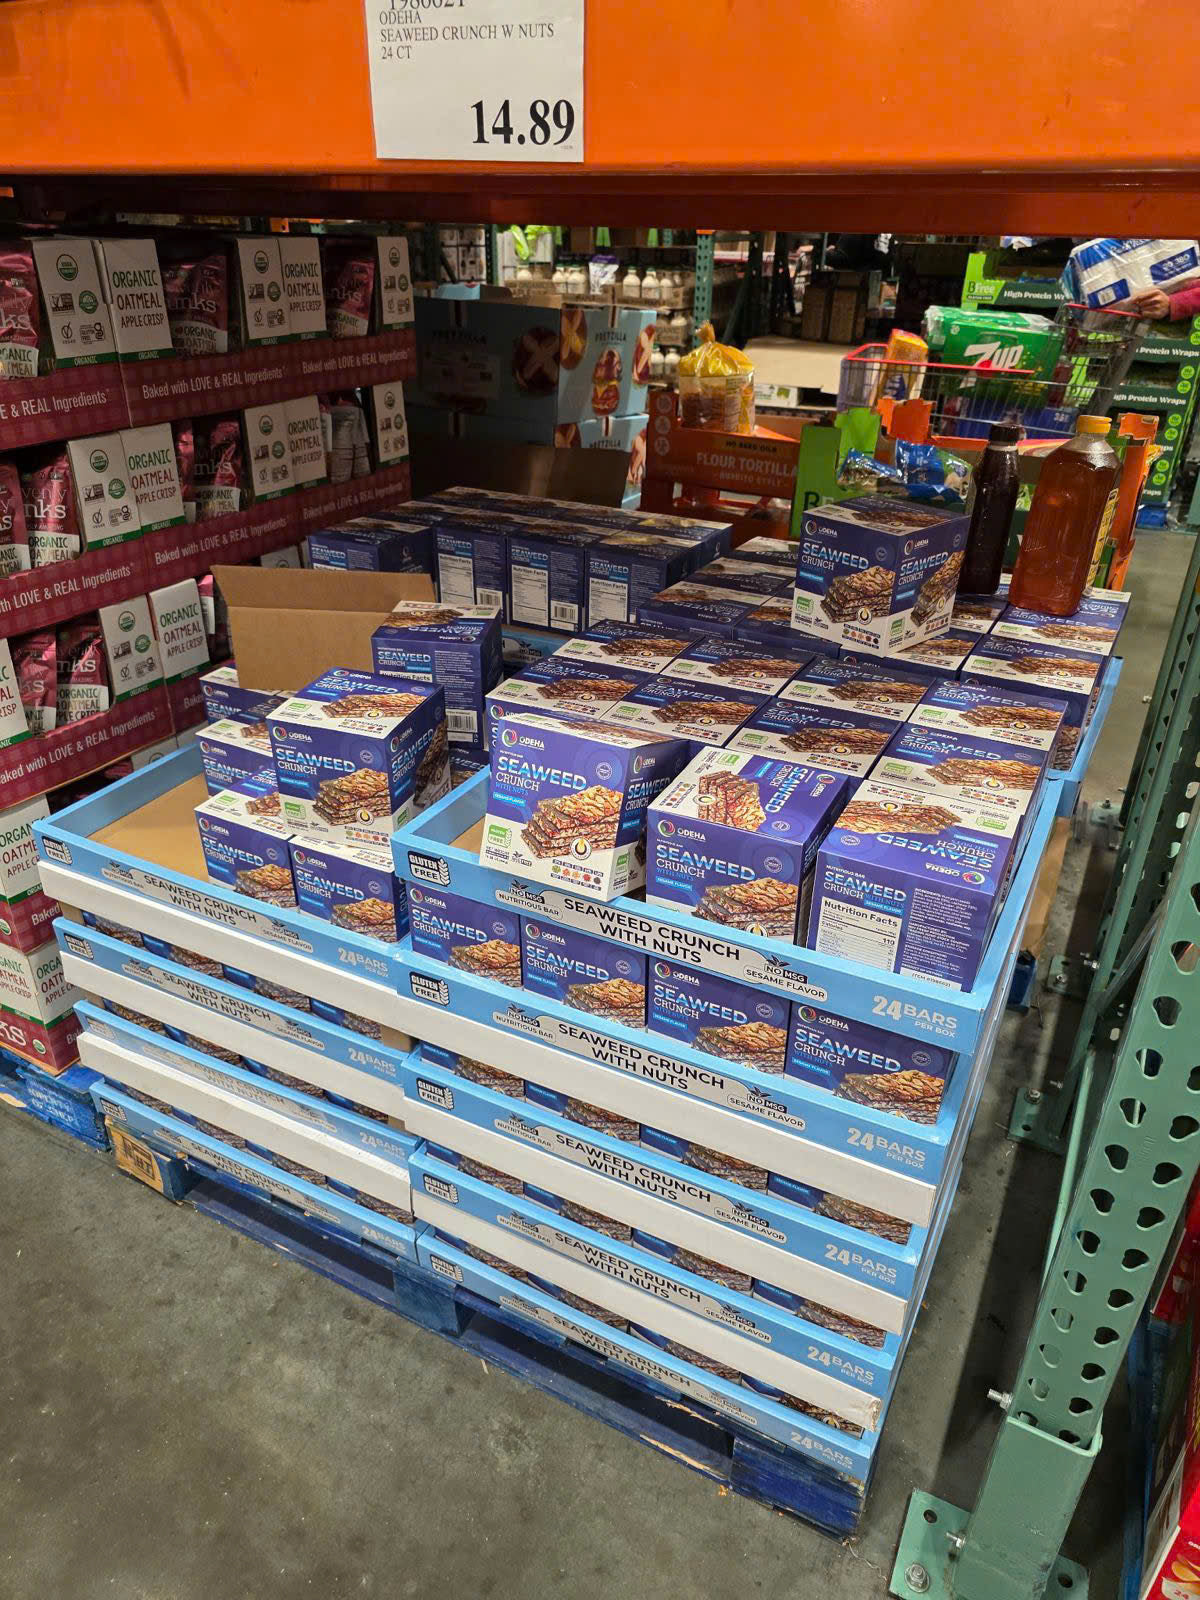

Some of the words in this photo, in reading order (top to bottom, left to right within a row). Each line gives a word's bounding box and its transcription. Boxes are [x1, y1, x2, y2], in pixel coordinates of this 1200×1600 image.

[380, 11, 422, 25] ODEHA
[380, 27, 438, 42] SEAWEED
[443, 25, 497, 40] CRUNCH
[502, 24, 514, 38] W
[519, 23, 554, 38] NUTS
[381, 46, 393, 60] 24
[396, 46, 412, 59] CT
[471, 99, 575, 145] 14.89
[113, 269, 158, 288] ORGANIC
[285, 263, 319, 278] ORGANIC
[117, 293, 162, 310] OATMEAL
[287, 283, 321, 298] OATMEAL
[1004, 290, 1022, 299] High
[1024, 291, 1052, 300] Protein
[302, 361, 323, 374] Baked
[338, 356, 355, 369] LOVE
[362, 353, 377, 365] REAL
[1140, 347, 1170, 355] Protein
[1172, 348, 1199, 358] Wraps
[142, 384, 169, 400] Baked
[171, 380, 189, 395] with
[190, 376, 211, 392] LOVE
[214, 376, 221, 388] &
[222, 373, 243, 387] REAL
[21, 398, 52, 416] REAL
[53, 391, 107, 413] Ingredients
[1128, 394, 1158, 403] Protein
[129, 448, 172, 470] ORGANIC
[696, 452, 736, 469] FLOUR
[132, 469, 174, 489] OATMEAL
[155, 548, 179, 565] Baked
[181, 542, 199, 557] with
[200, 535, 220, 551] LOVE
[230, 528, 249, 542] REAL
[512, 548, 549, 561] SEAWEED
[802, 542, 869, 570] SEAWEED
[590, 561, 629, 575] SEAWEED
[801, 555, 835, 571] CRUNCH
[900, 551, 949, 577] SEAWEED
[14, 590, 40, 609] LOVE
[54, 581, 81, 598] REAL
[82, 565, 131, 589] Ingredients
[898, 571, 923, 586] CRUNCH
[160, 603, 199, 628] ORGANIC
[163, 622, 202, 645] OATMEAL
[378, 650, 431, 664] SEAWEED
[321, 676, 399, 695] SEAWEED
[938, 685, 1027, 708] SEAWEED
[765, 705, 856, 729] SEAWEED
[26, 757, 47, 773] with
[49, 745, 73, 764] LOVE
[85, 730, 110, 747] REAL
[519, 735, 545, 749] ODEHA
[903, 734, 1002, 761] SEAWEED
[276, 748, 356, 773] SEAWEED
[278, 761, 317, 776] CRUNCH
[496, 773, 541, 792] CRUNCH
[497, 756, 587, 791] SEAWEED
[627, 777, 671, 801] SEAWEED
[767, 767, 802, 814] SEAWEED
[678, 827, 706, 842] ODEHA
[203, 836, 264, 867] SEAWEED
[876, 833, 994, 869] SEAWEED
[936, 839, 997, 861] CRUNCH
[409, 854, 438, 871] GLUTEN
[656, 844, 756, 882] SEAWEED
[656, 858, 705, 879] CRUNCH
[925, 862, 960, 878] ODEHA
[296, 869, 365, 900] SEAWEED
[414, 867, 438, 882] FREE
[824, 870, 907, 902] SEAWEED
[143, 874, 201, 902] SEAWEED
[204, 896, 256, 923] CRUNCH
[298, 883, 332, 899] CRUNCH
[823, 881, 865, 900] CRUNCH
[31, 902, 61, 926] Baked
[170, 895, 202, 914] WITH
[203, 907, 236, 926] NUTS
[543, 905, 560, 917] BAR
[824, 900, 869, 920] Nutrition
[869, 911, 898, 928] Facts
[412, 908, 488, 942] SEAWEED
[412, 920, 451, 940] CRUNCH
[563, 898, 653, 934] SEAWEED
[657, 926, 741, 961] CRUNCH
[541, 931, 566, 945] ODEHA
[599, 922, 648, 947] WITH
[652, 939, 703, 964] NUTS
[526, 945, 610, 981] SEAWEED
[526, 957, 568, 978] CRUNCH
[766, 964, 782, 976] NO
[784, 970, 807, 984] MSG
[411, 974, 439, 991] GLUTEN
[672, 970, 700, 985] ODEHA
[746, 968, 784, 990] SESAME
[786, 980, 826, 1000] FLAVOR
[163, 973, 219, 1000] SEAWEED
[219, 995, 271, 1021] CRUNCH
[415, 987, 439, 1001] FREE
[653, 983, 748, 1024] SEAWEED
[653, 996, 700, 1020] CRUNCH
[873, 995, 903, 1021] 24
[903, 1003, 958, 1030] BARS
[819, 1014, 849, 1031] ODEHA
[913, 1019, 934, 1033] PER
[935, 1024, 956, 1038] BOX
[558, 1022, 642, 1061] SEAWEED
[647, 1054, 725, 1090] CRUNCH
[794, 1041, 846, 1067] CRUNCH
[795, 1028, 901, 1072] SEAWEED
[591, 1047, 637, 1072] WITH
[642, 1065, 689, 1090] NUTS
[418, 1080, 445, 1097] GLUTEN
[421, 1092, 445, 1106] FREE
[729, 1096, 767, 1115] SESAME
[768, 1108, 804, 1129] FLAVOR
[747, 1093, 763, 1106] NO
[765, 1099, 786, 1113] MSG
[848, 1127, 875, 1152] 24
[874, 1135, 926, 1162] BARS
[555, 1133, 635, 1172] SEAWEED
[639, 1166, 711, 1202] CRUNCH
[587, 1157, 630, 1181] WITH
[634, 1176, 679, 1201] NUTS
[555, 1232, 629, 1270] SEAWEED
[633, 1266, 701, 1303] CRUNCH
[825, 1244, 850, 1266] 24
[851, 1254, 897, 1279] BARS
[585, 1254, 625, 1279] WITH
[629, 1275, 670, 1299] NUTS
[553, 1316, 623, 1354] SEAWEED
[627, 1347, 691, 1387] CRUNCH
[808, 1345, 831, 1368] 24
[831, 1356, 875, 1382] BARS
